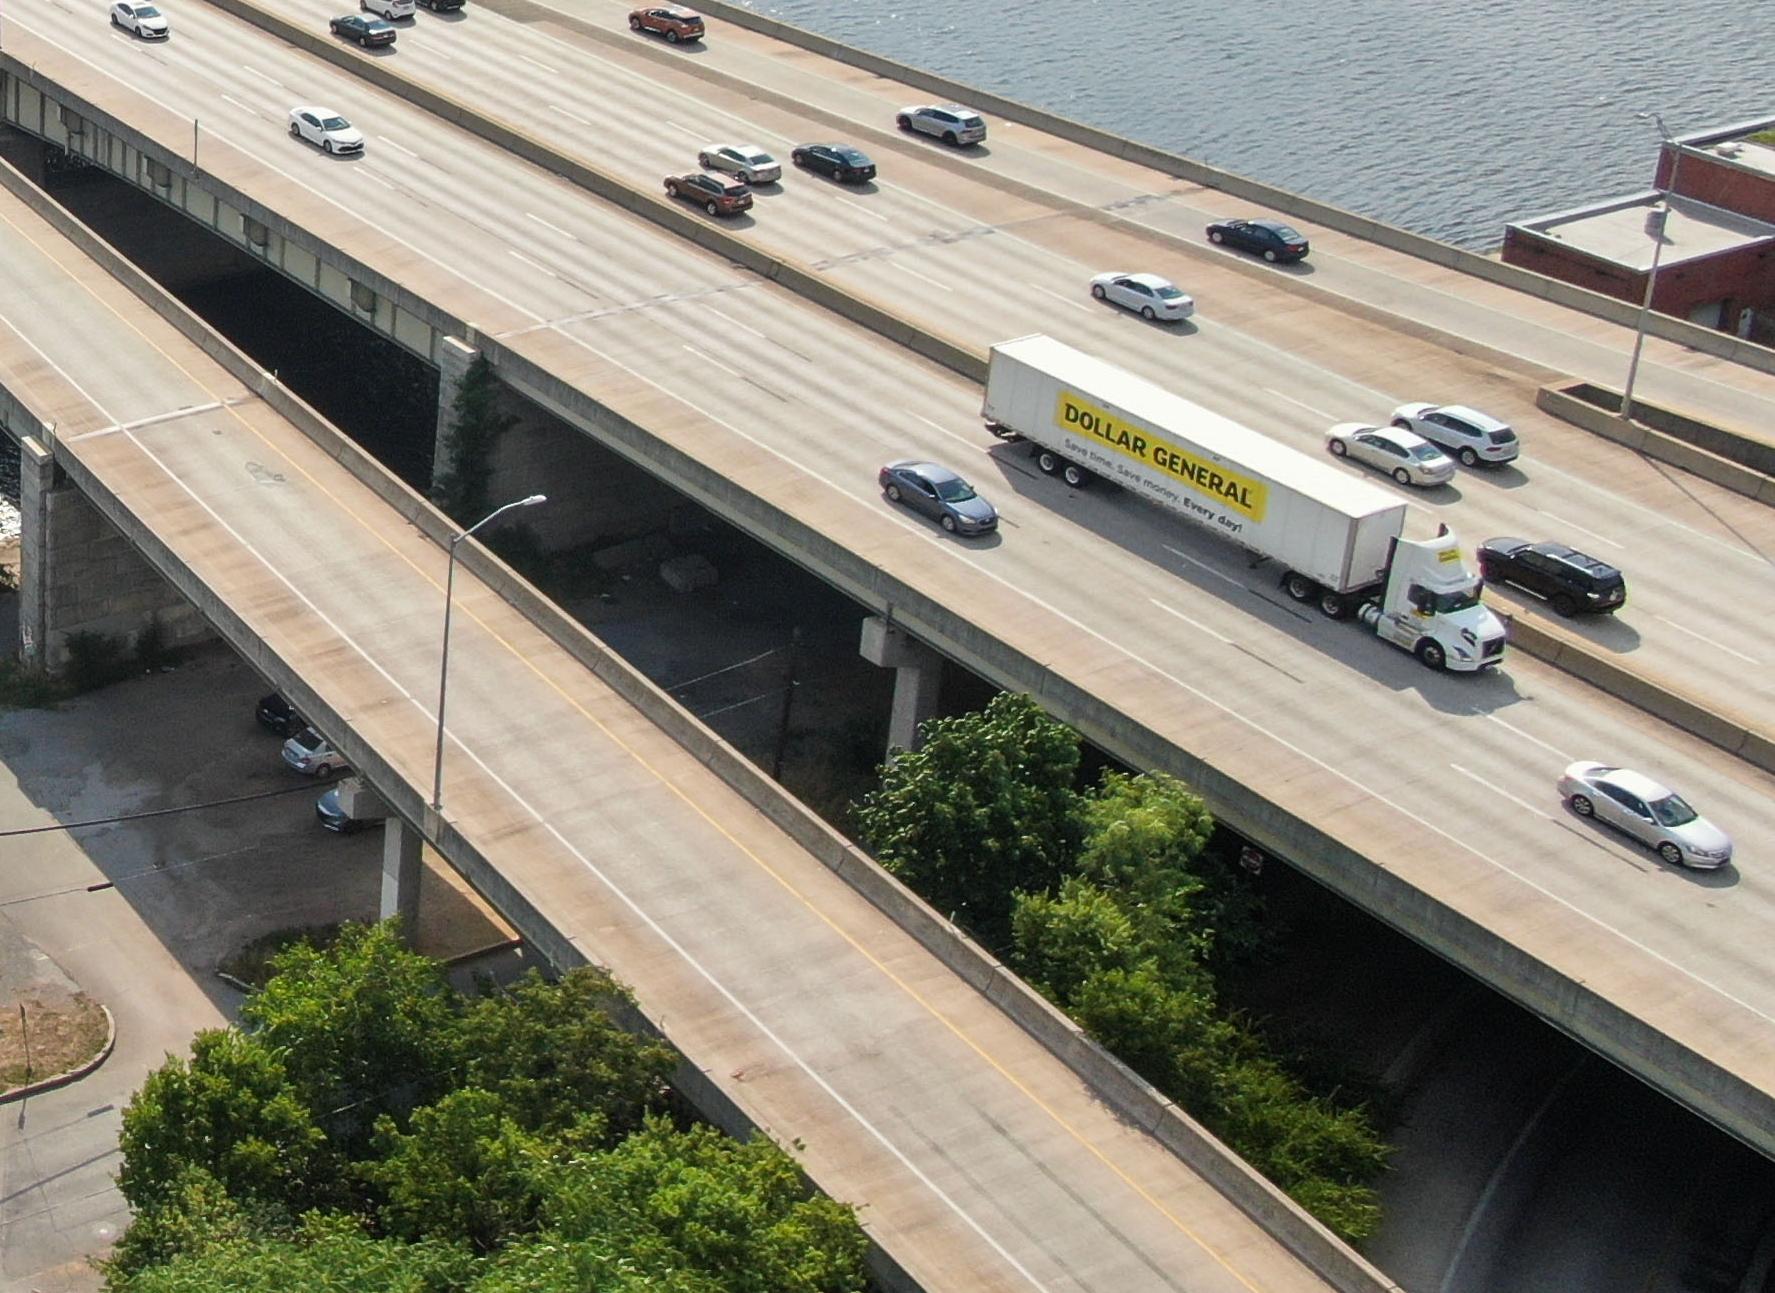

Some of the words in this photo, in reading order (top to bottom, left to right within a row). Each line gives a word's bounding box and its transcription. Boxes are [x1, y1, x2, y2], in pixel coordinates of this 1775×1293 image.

[1065, 402, 1147, 458] DOLLAR
[1153, 446, 1252, 509] GENERAL
[1065, 438, 1088, 457] Save
[1117, 464, 1142, 483] Save
[1183, 497, 1215, 520] Every
[1217, 515, 1243, 533] day!
